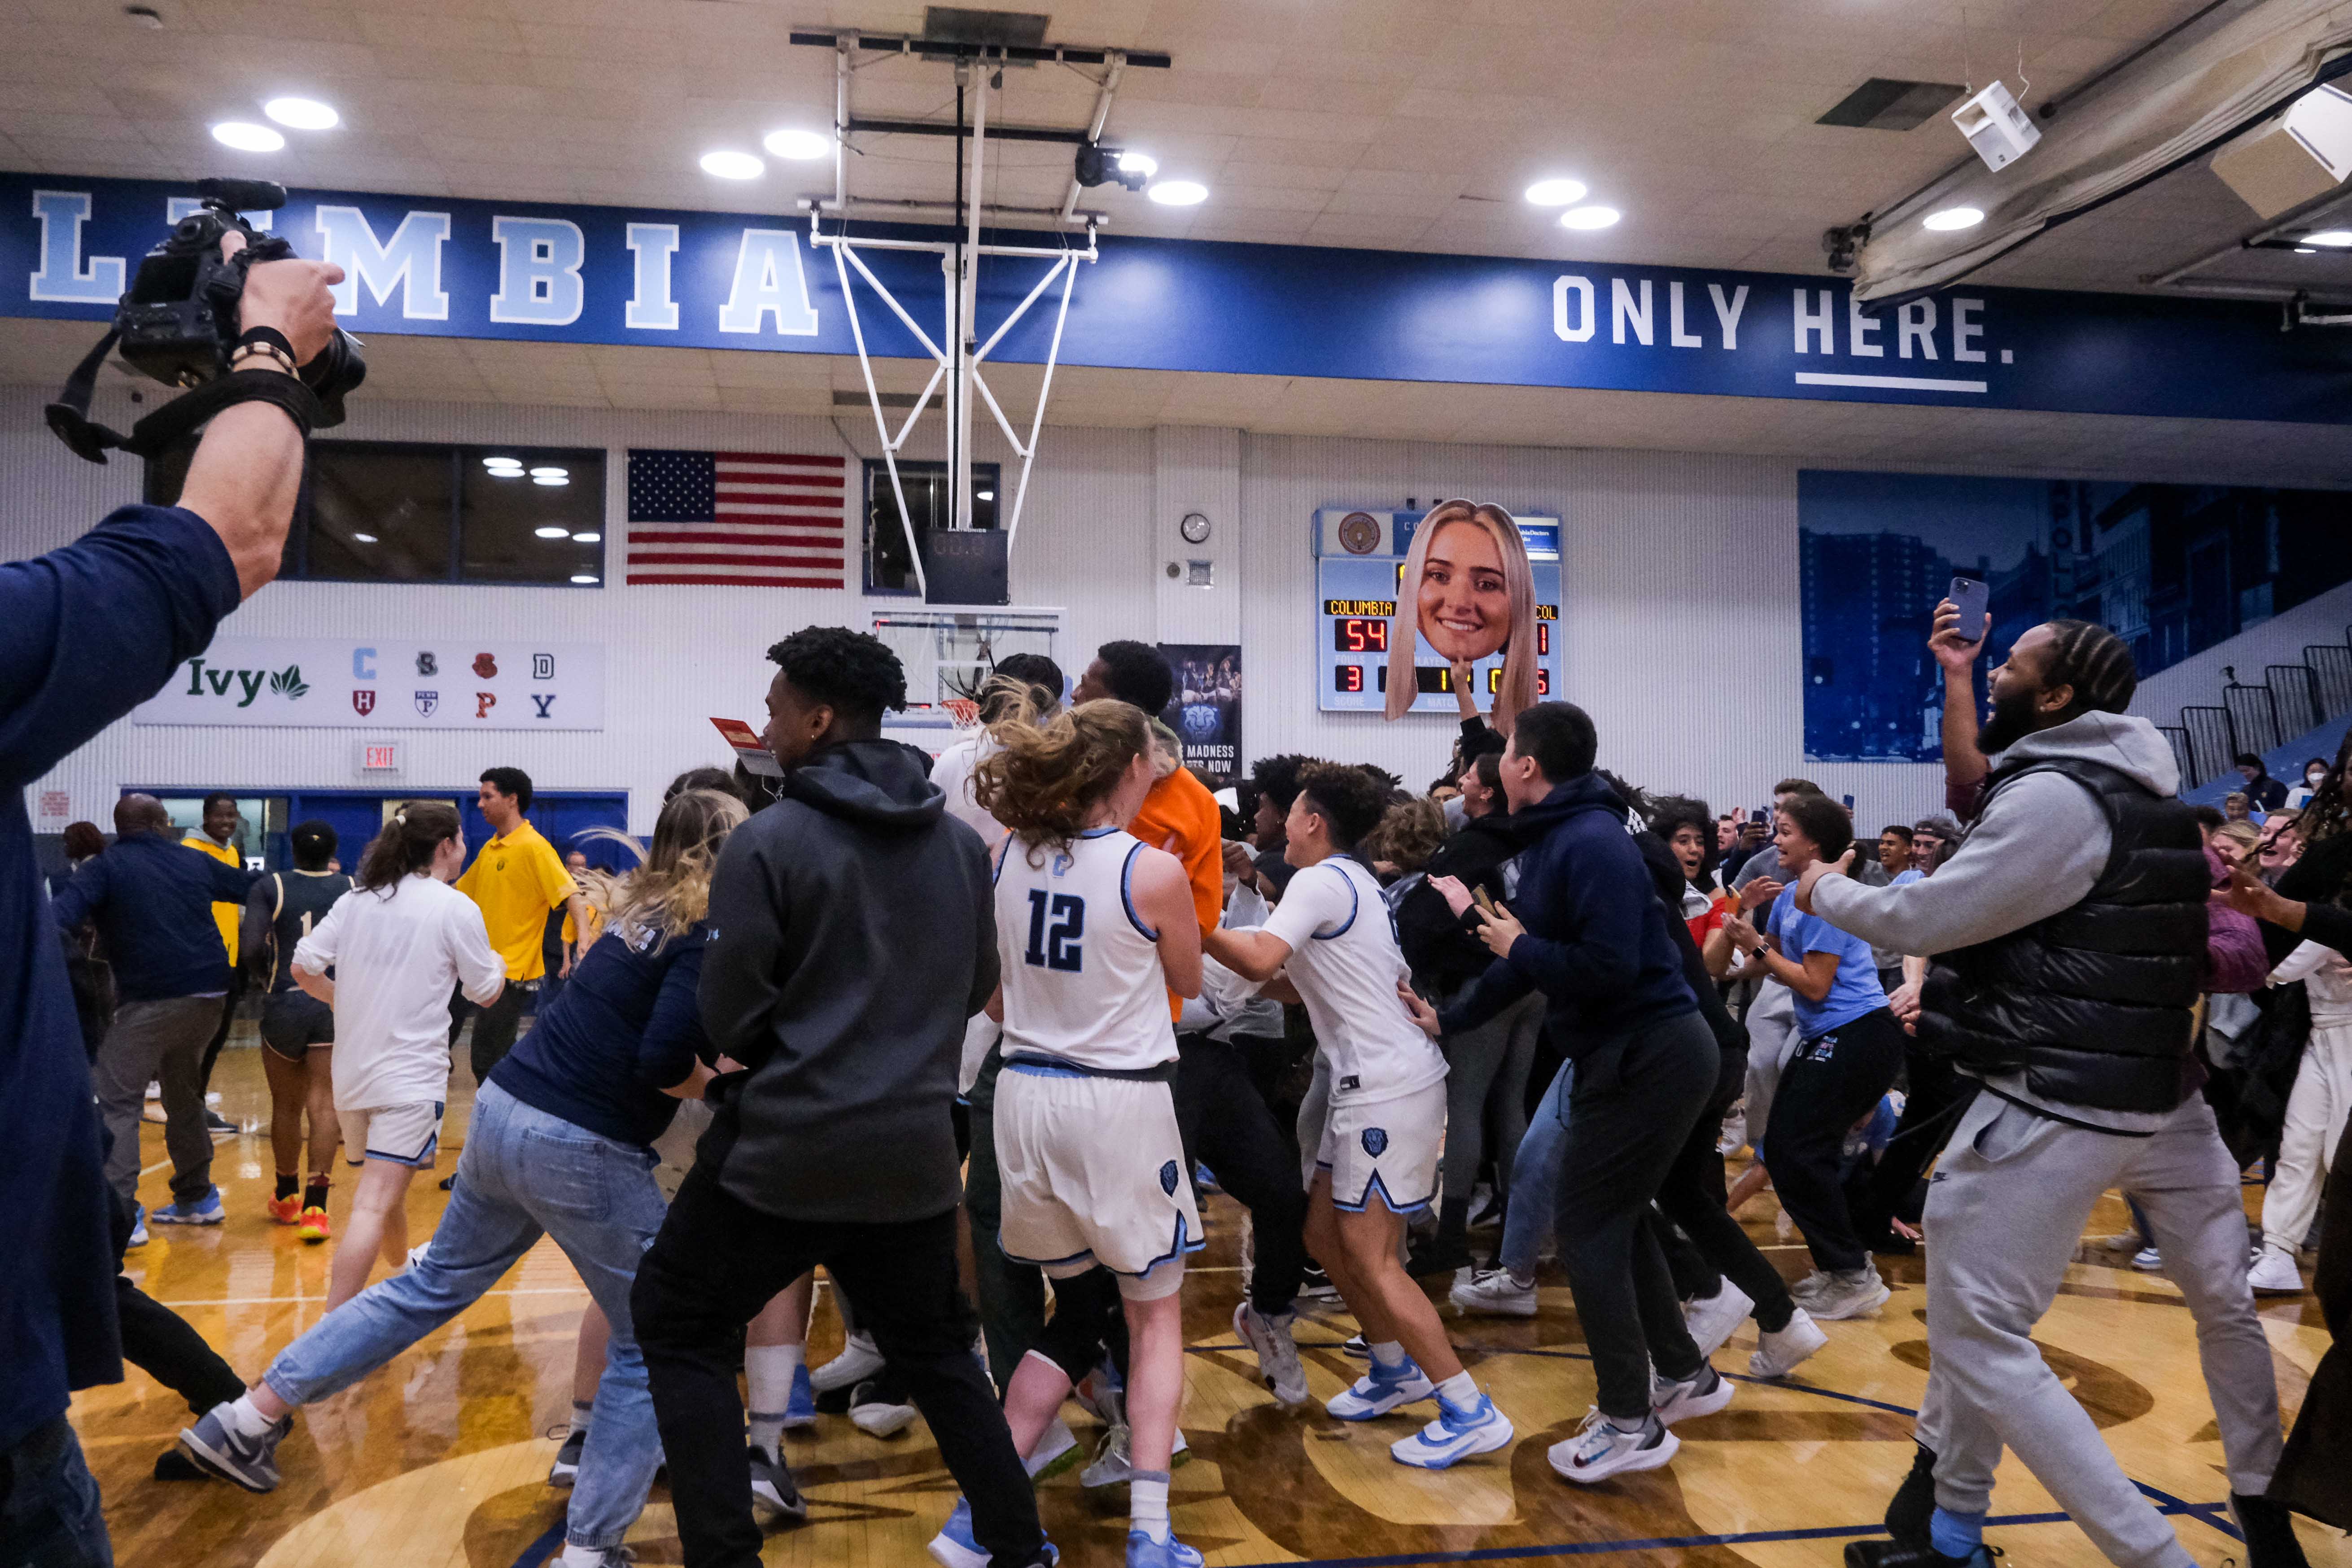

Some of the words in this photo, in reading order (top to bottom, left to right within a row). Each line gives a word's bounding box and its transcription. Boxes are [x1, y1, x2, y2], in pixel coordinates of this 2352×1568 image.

[30, 190, 818, 336] LMBIA
[1553, 275, 1749, 350] ONLY
[1793, 288, 2014, 364] HERE.
[1331, 600, 1392, 616] COLUMBIA
[1348, 620, 1384, 651] 54
[353, 648, 376, 679] C
[533, 654, 554, 679] D
[187, 659, 266, 708] Ivy
[1348, 667, 1360, 691] 3
[357, 692, 371, 709] H
[476, 692, 496, 718] P
[530, 694, 556, 718] Y
[1334, 695, 1364, 707] SCORE
[366, 746, 394, 768] EXIT
[1187, 745, 1234, 758] MADNESS
[1208, 760, 1232, 773] NOW
[1025, 888, 1086, 973] 12
